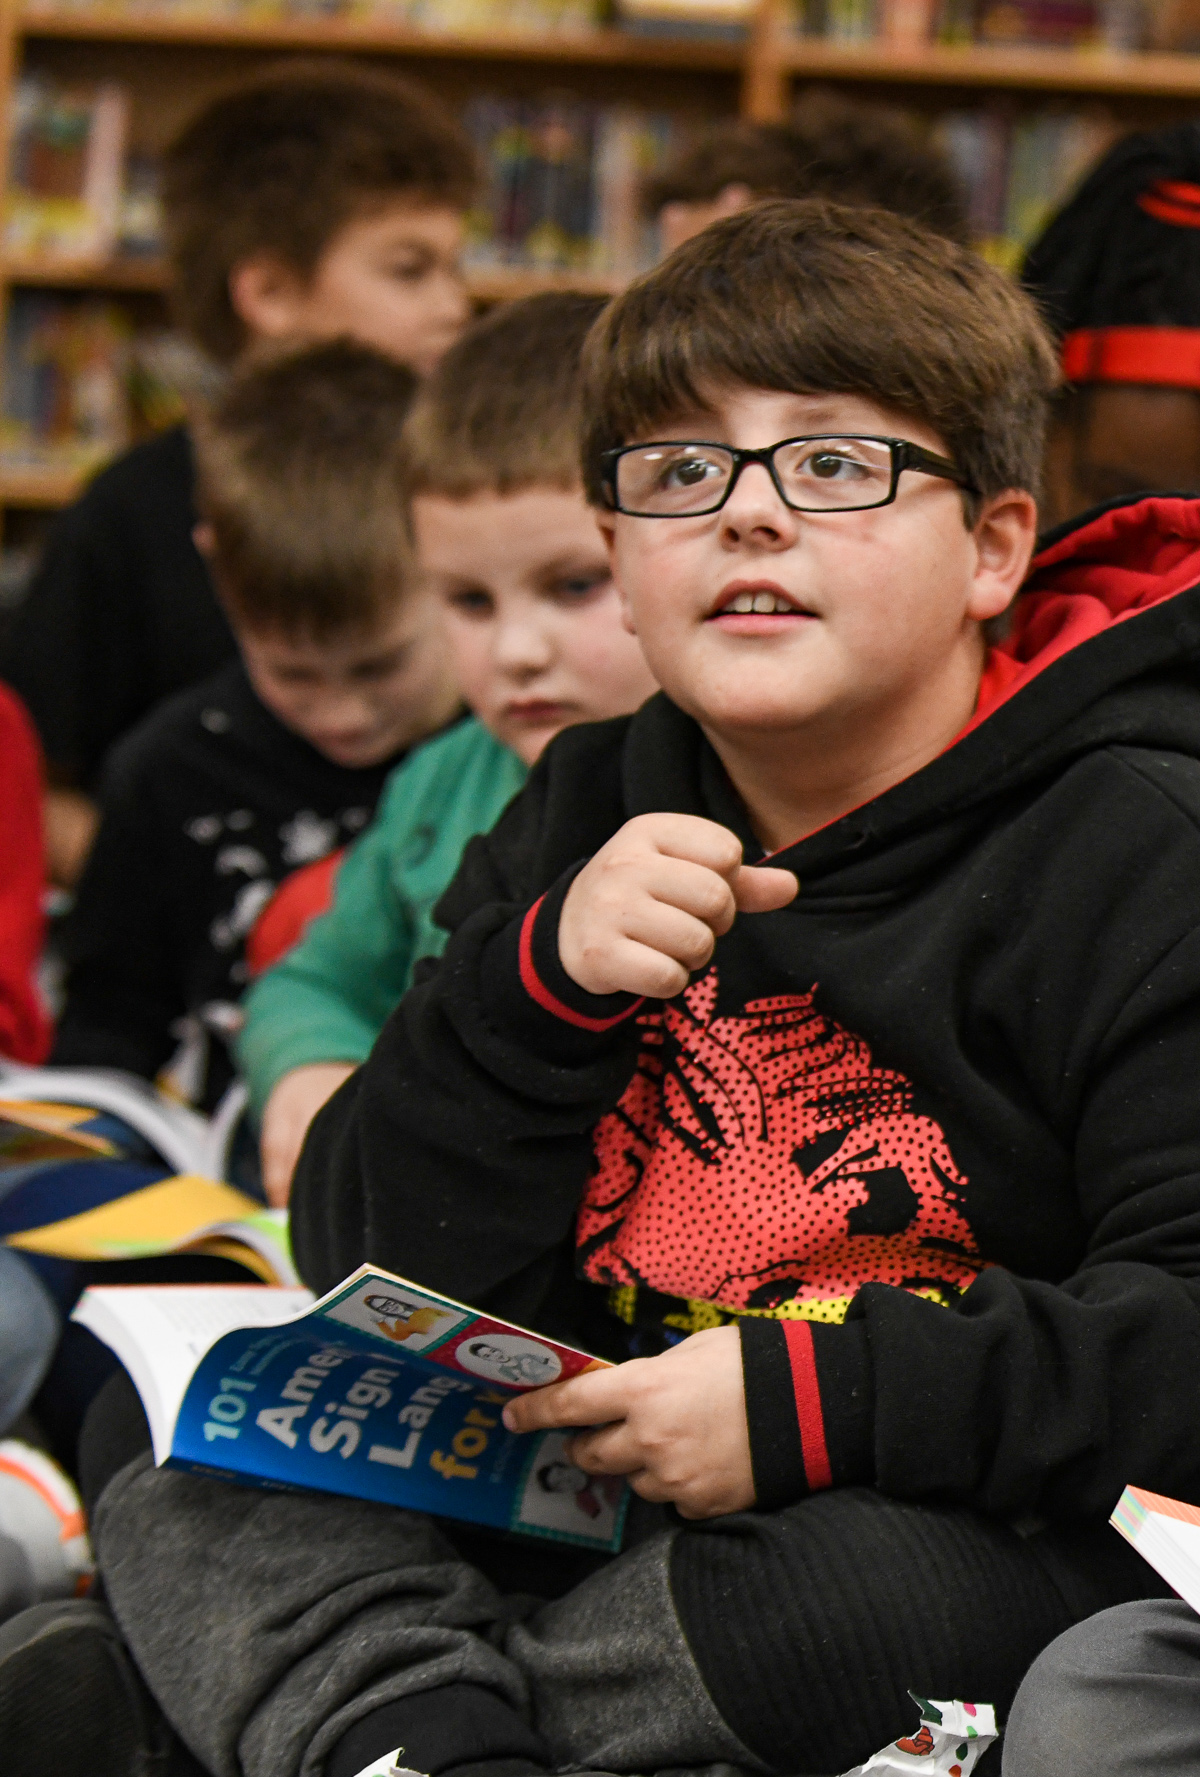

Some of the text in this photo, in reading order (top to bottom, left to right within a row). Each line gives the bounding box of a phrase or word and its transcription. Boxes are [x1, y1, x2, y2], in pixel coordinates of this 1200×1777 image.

[203, 1377, 257, 1442] 101
[309, 1367, 400, 1460] Sign
[367, 1376, 473, 1469] Lang
[429, 1408, 497, 1479] for
